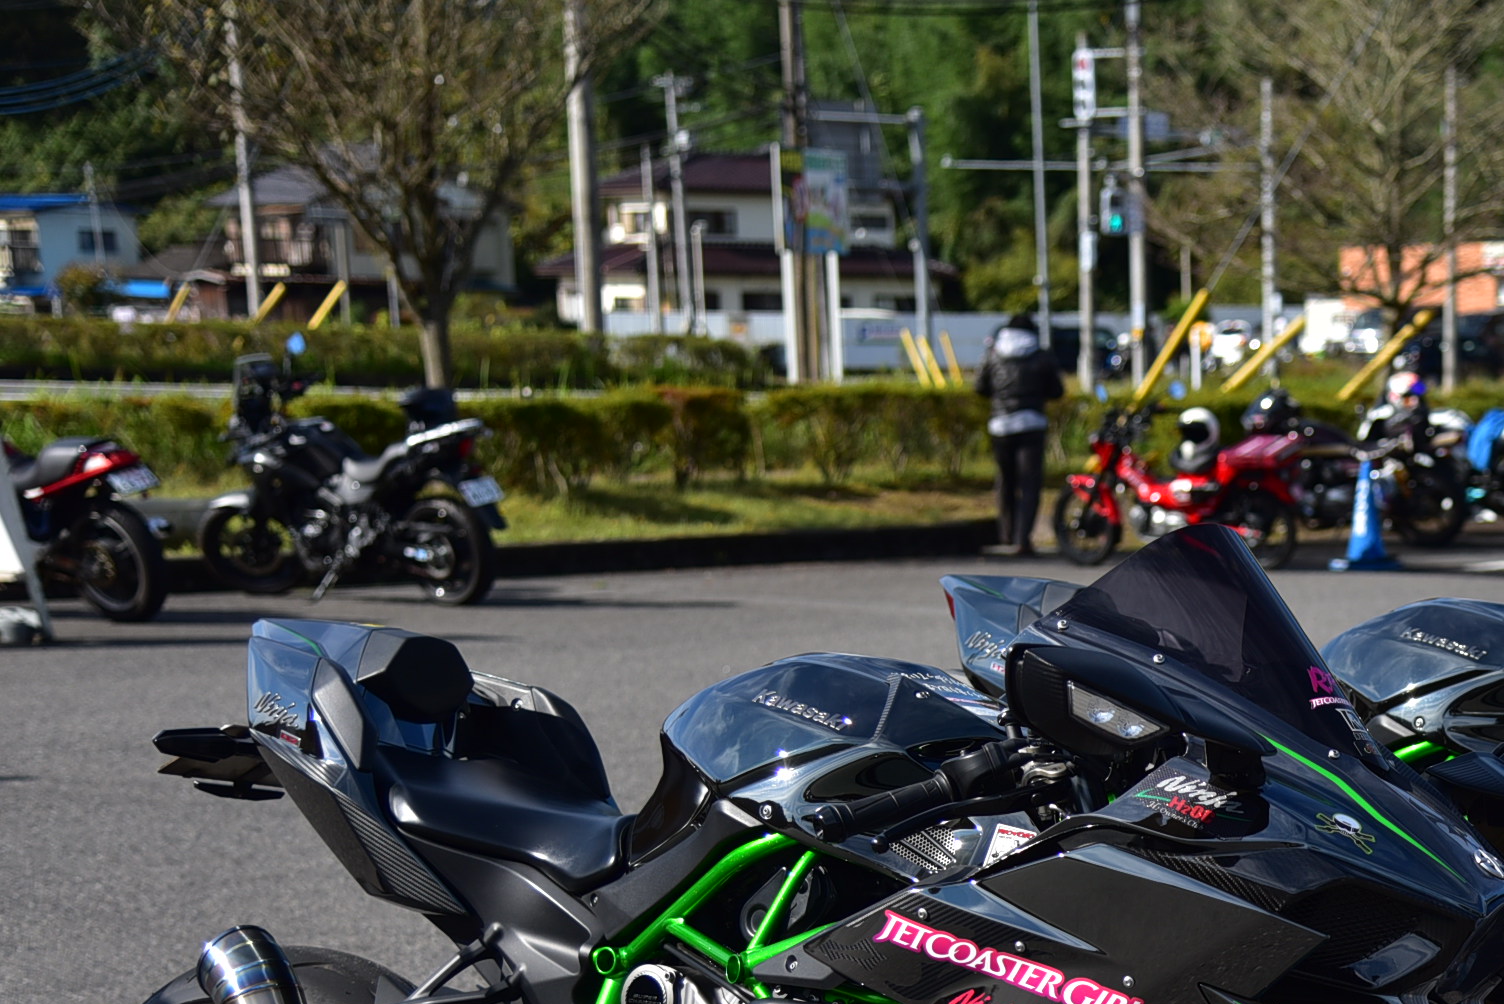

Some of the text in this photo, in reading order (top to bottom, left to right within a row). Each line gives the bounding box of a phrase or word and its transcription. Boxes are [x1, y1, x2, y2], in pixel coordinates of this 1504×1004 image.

[1400, 627, 1487, 660] Kawasaki
[253, 691, 299, 728] Ninja
[752, 688, 852, 731] Kawasaki
[1156, 775, 1244, 814] Ninja
